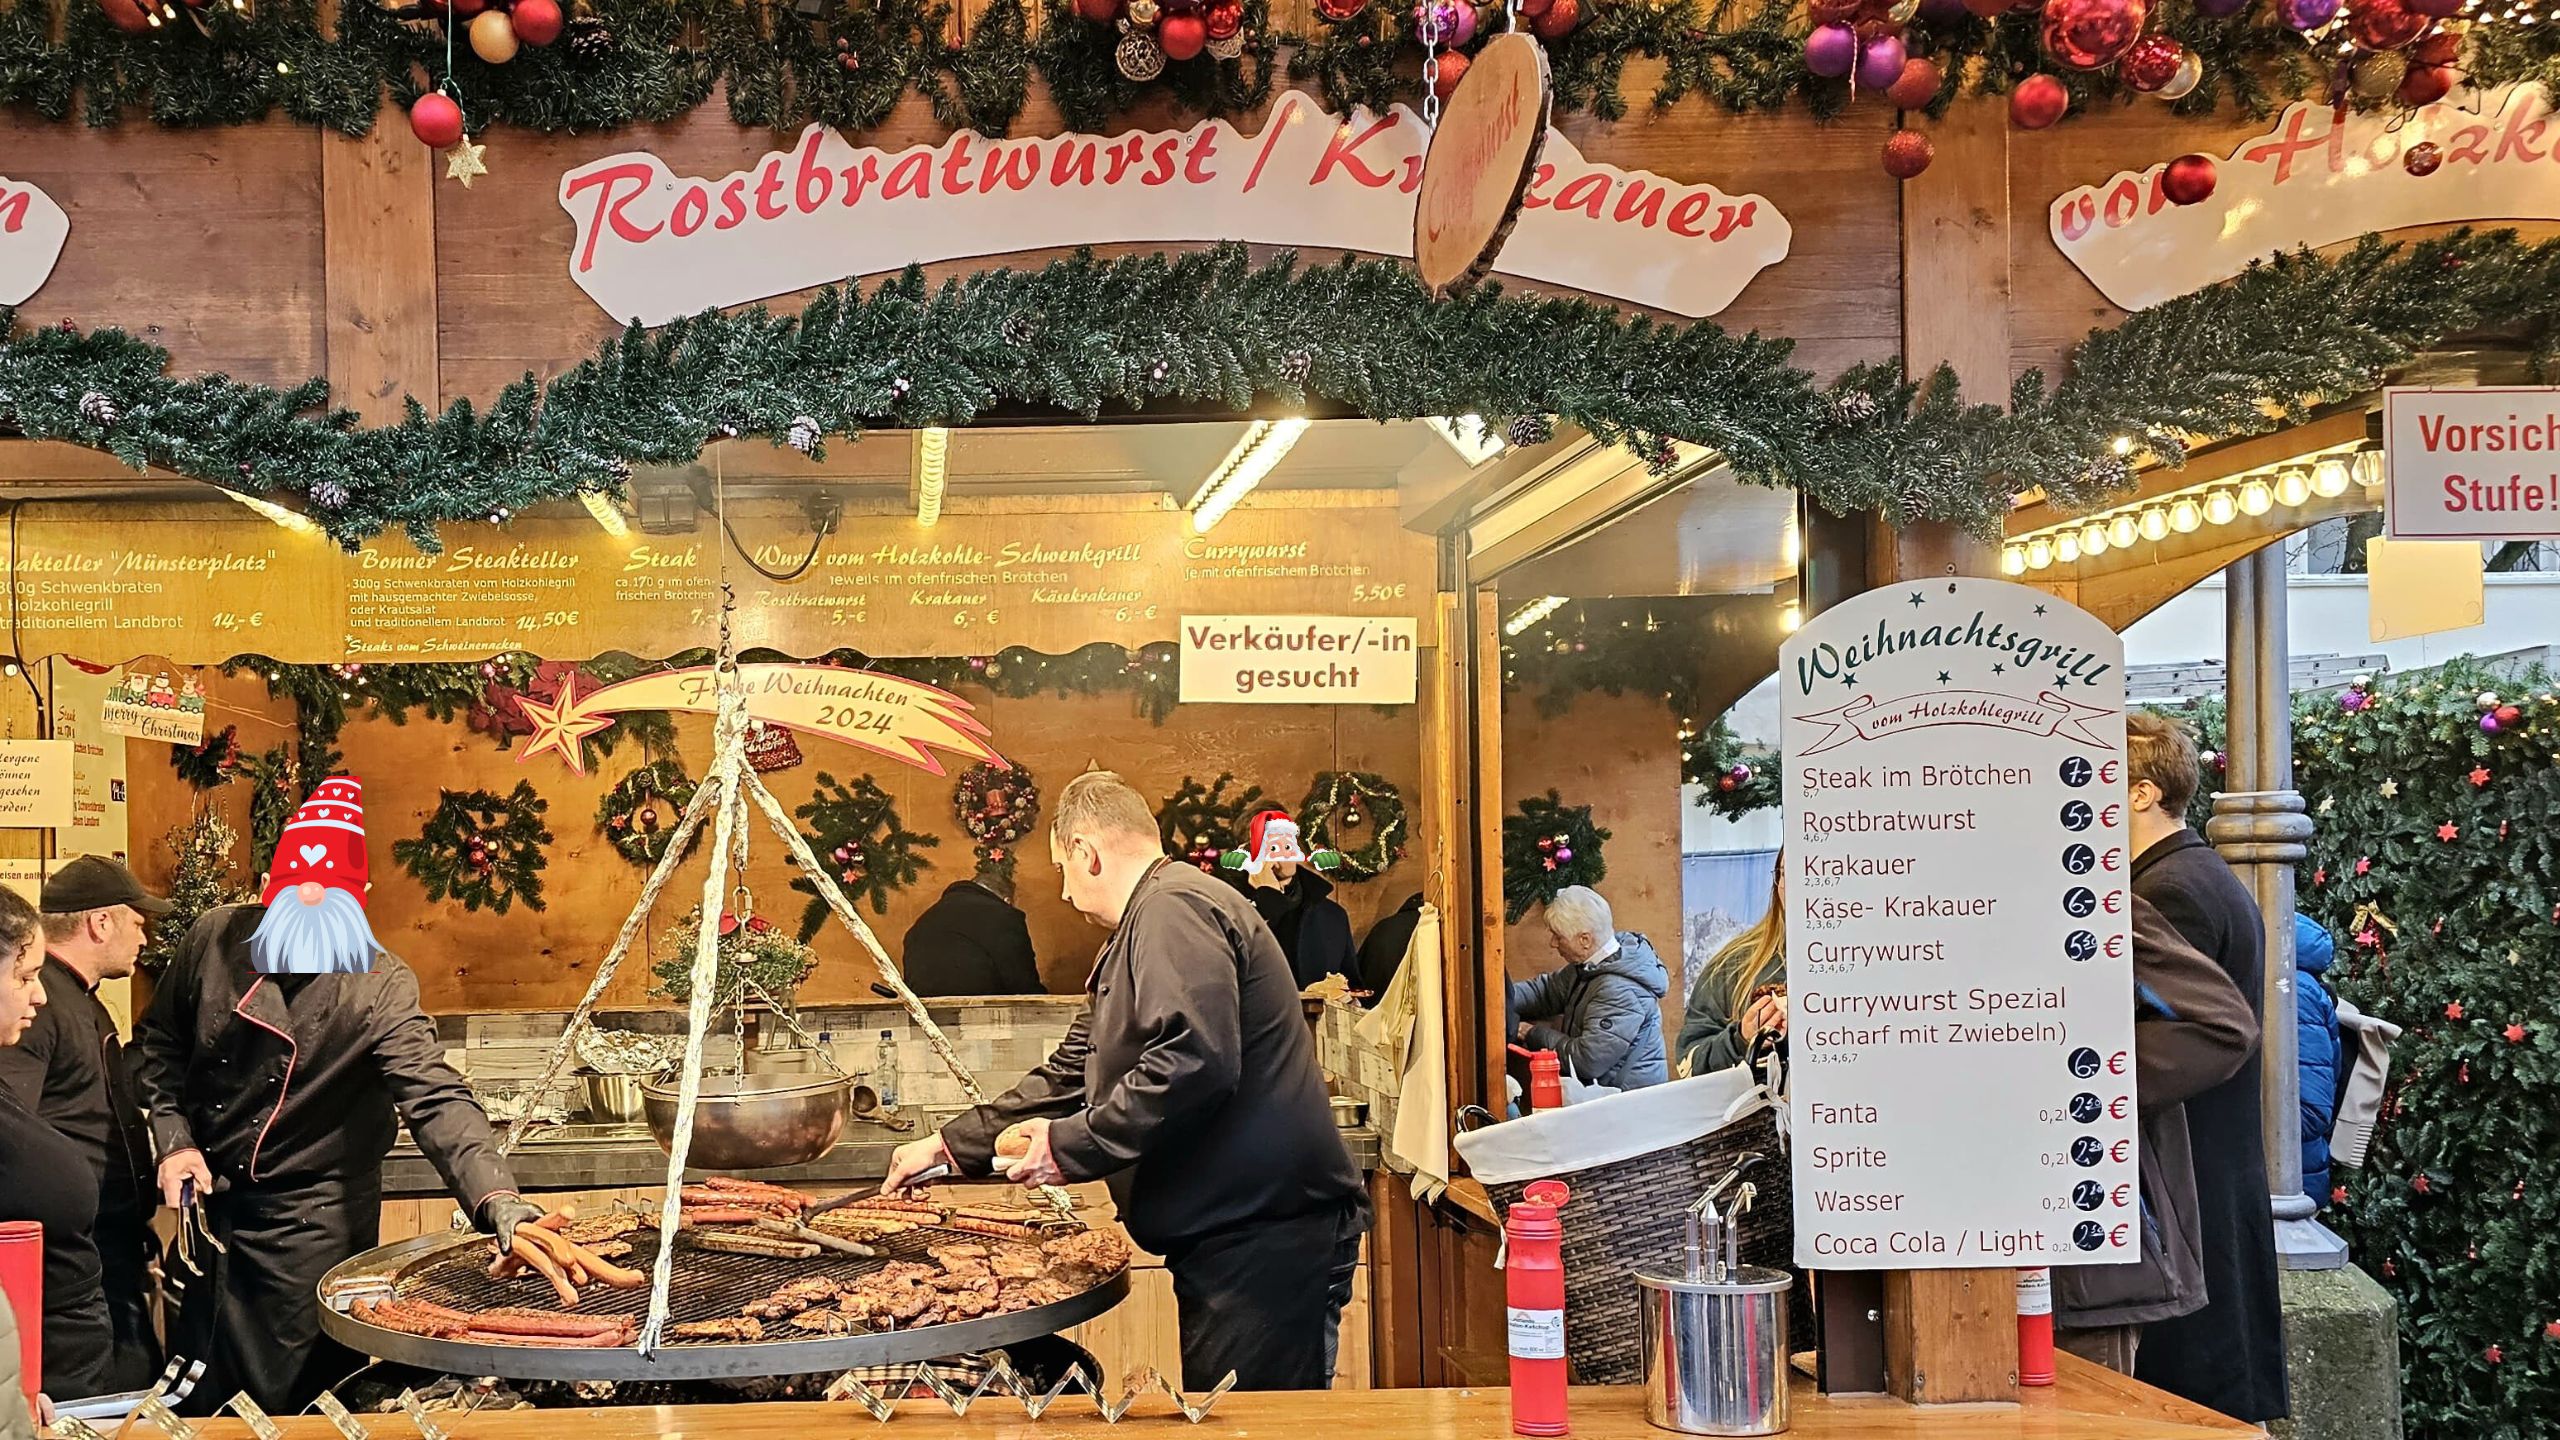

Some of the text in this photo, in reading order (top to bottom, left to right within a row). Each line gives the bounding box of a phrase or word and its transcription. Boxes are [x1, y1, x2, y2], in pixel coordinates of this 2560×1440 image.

[566, 99, 1758, 273] Rostbratwurst / Krkauer
[2444, 474, 2557, 512] Stufe!
[358, 549, 437, 569] Bonner
[826, 552, 865, 565] vom
[871, 543, 992, 566] Holzkohle-
[995, 541, 1141, 569] Schwenkgrill
[1184, 536, 1308, 566] Currywurst
[111, 549, 276, 579] "Münsterplatz"
[1202, 566, 1220, 578] mit
[1223, 564, 1308, 578] ofenfrischem
[42, 581, 162, 594] Schwenkbraten
[352, 578, 576, 591] 300g Schwenkbraten vom Holzkohlegrill
[885, 573, 903, 585] im
[908, 571, 997, 585] ofenfrischen
[1002, 570, 1068, 584] Brötchen
[350, 592, 368, 602] mit
[372, 592, 457, 604] hausgemachter
[616, 590, 661, 600] frischen
[753, 590, 866, 606] Rostbratwurst
[909, 589, 986, 606] Krakauer
[1030, 585, 1142, 604] Käsekrakauer
[114, 615, 183, 628] Landbrot
[350, 605, 436, 615] oder Krautsalat
[350, 616, 506, 628] und traditionellem Landbrot
[396, 643, 420, 652] vom
[421, 637, 523, 654] Schweinenacken
[1187, 624, 1412, 655] Verkäufer/-in
[1797, 610, 2111, 696] Weihnachtsgrill
[763, 671, 908, 707] Weihnachten
[1235, 662, 1360, 694] gesucht
[103, 705, 140, 726] Merry
[816, 705, 894, 735] 2024
[1872, 699, 2045, 730] vom Holzkohlegrill
[142, 716, 200, 741] Christmas
[1802, 767, 1873, 790] Steak
[1882, 766, 1912, 788] im
[1922, 764, 2032, 787] Brötchen
[2098, 760, 2119, 784] €
[1803, 788, 1820, 799] 6,7
[1803, 808, 1977, 834] Rostbratwurst
[2099, 804, 2121, 828] €
[1803, 832, 1830, 844] 4,6,7
[1805, 854, 1916, 877] Krakauer
[2100, 847, 2122, 872] €
[1804, 877, 1841, 888] 2,3,6,7
[1806, 897, 1874, 920] Käse-
[1885, 895, 1998, 918] Krakauer
[2102, 890, 2123, 914] €
[1806, 920, 1843, 931] 2,3,6,7
[1807, 939, 1945, 967] Currywurst
[2103, 934, 2124, 958] €
[1808, 963, 1855, 975] 2,3,4,6,7
[1803, 985, 2067, 1018] Currywurst Spezial
[1805, 1021, 2068, 1051] (scharf mit Zwiebeln)
[1811, 1053, 1859, 1065] 2,3,4,6,7
[2106, 1051, 2127, 1075] €
[1811, 1103, 1879, 1125] Fanta
[2108, 1095, 2129, 1120] €
[1813, 1146, 1888, 1174] Sprite
[2109, 1139, 2130, 1163] €
[1815, 1190, 1905, 1213] Wasser
[2110, 1183, 2131, 1208] €
[1814, 1232, 1879, 1255] Coca
[1889, 1230, 1947, 1254] Cola
[1957, 1230, 1968, 1256] /
[1979, 1229, 2045, 1257] Light
[2108, 1223, 2129, 1248] €
